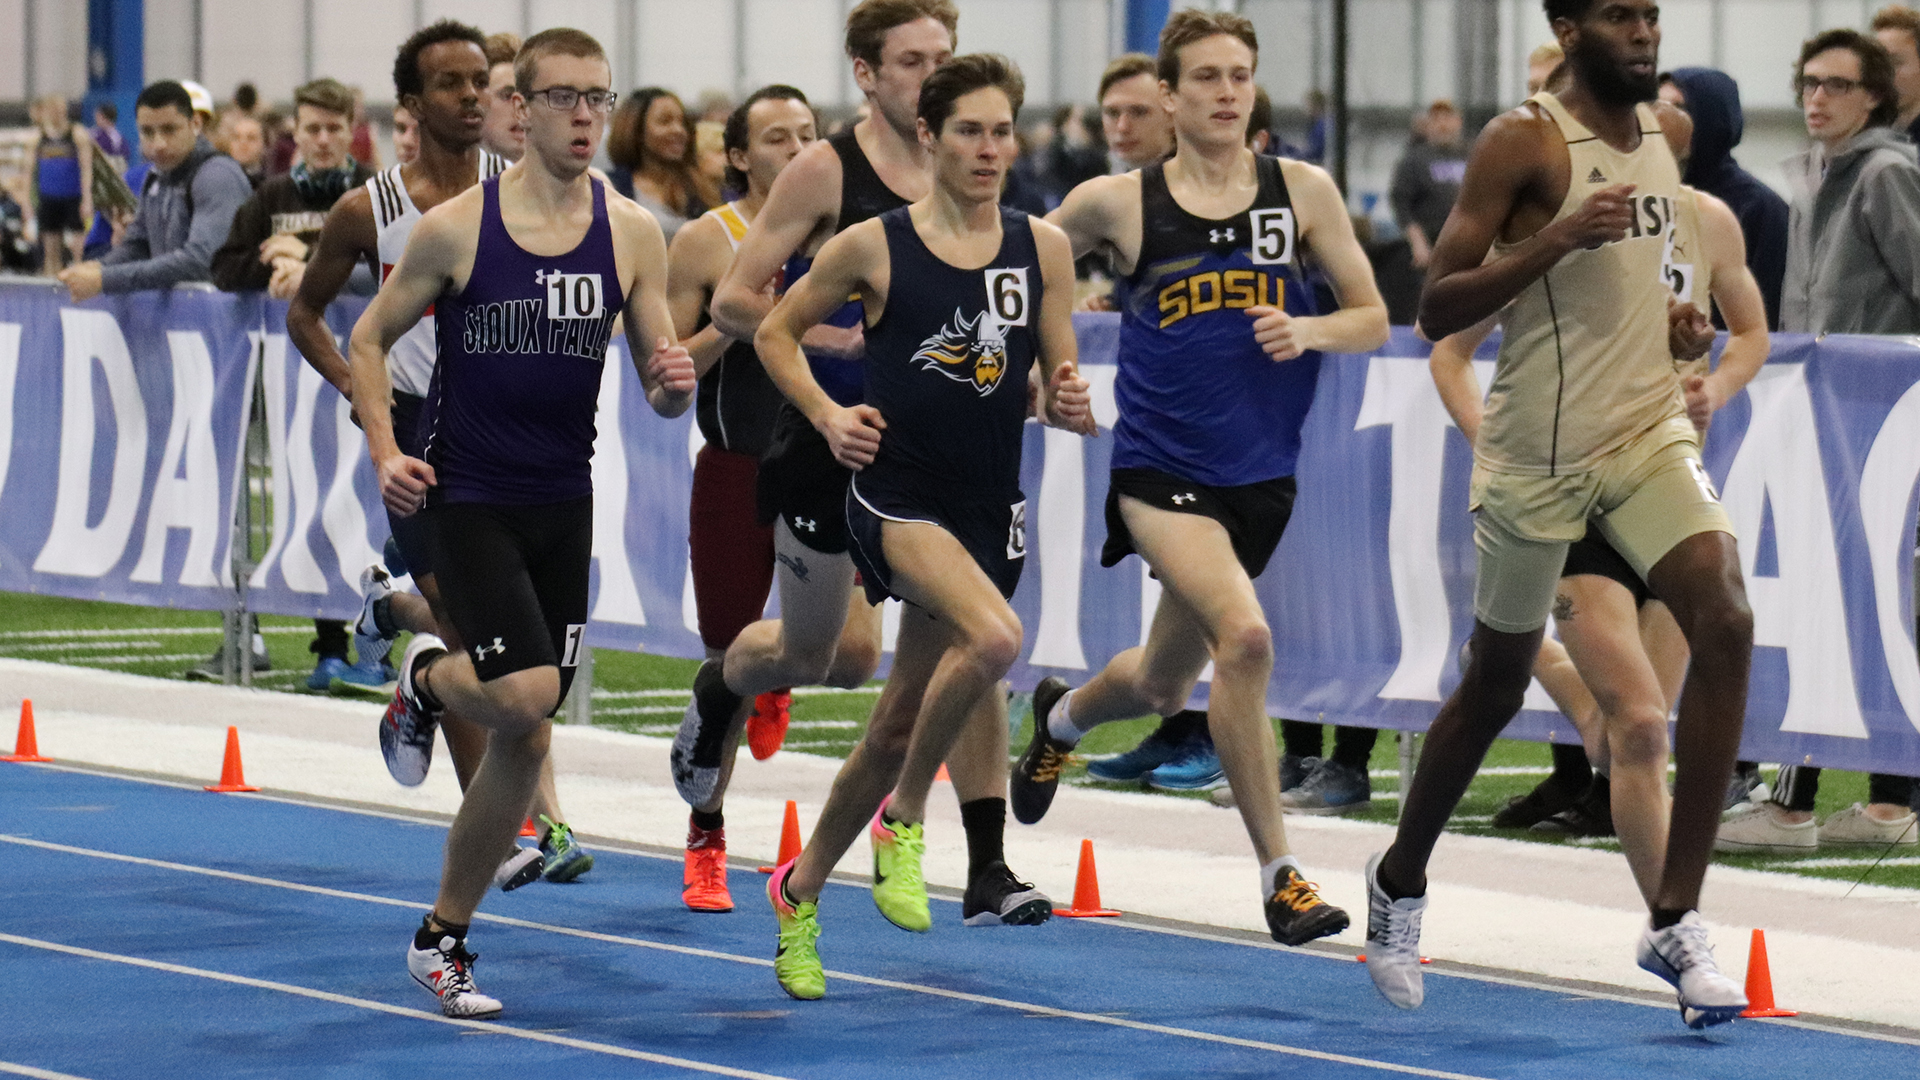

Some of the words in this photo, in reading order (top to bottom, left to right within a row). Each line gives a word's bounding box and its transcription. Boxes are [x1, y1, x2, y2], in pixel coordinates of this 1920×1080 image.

[1258, 213, 1286, 260] 5
[552, 276, 595, 316] 10
[993, 272, 1023, 321] 6
[1158, 270, 1285, 329] SDSU
[464, 299, 543, 354] SIOUX
